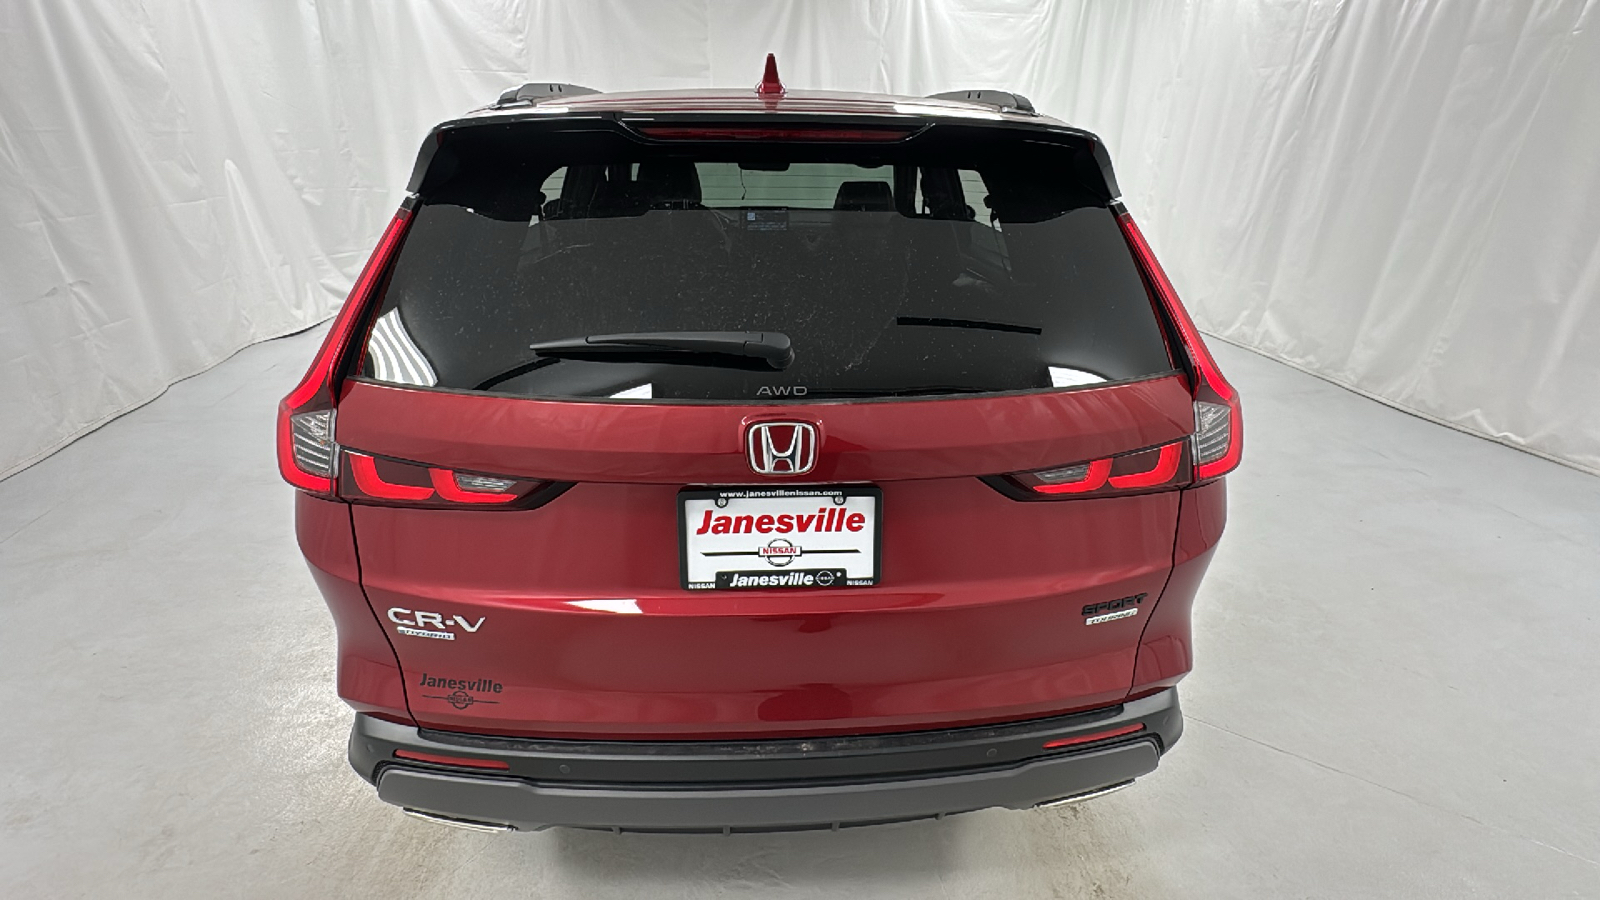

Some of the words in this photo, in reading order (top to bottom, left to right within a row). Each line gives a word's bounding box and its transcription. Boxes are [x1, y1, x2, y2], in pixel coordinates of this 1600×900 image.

[756, 386, 808, 396] AWD
[720, 490, 843, 498] www.janesvillenissan.com
[696, 507, 866, 535] Janesville
[762, 547, 797, 555] NISSAN
[730, 572, 814, 587] Janesville
[1081, 592, 1148, 615] SPORT
[387, 607, 486, 632] CR-V
[419, 672, 503, 693] Janesville
